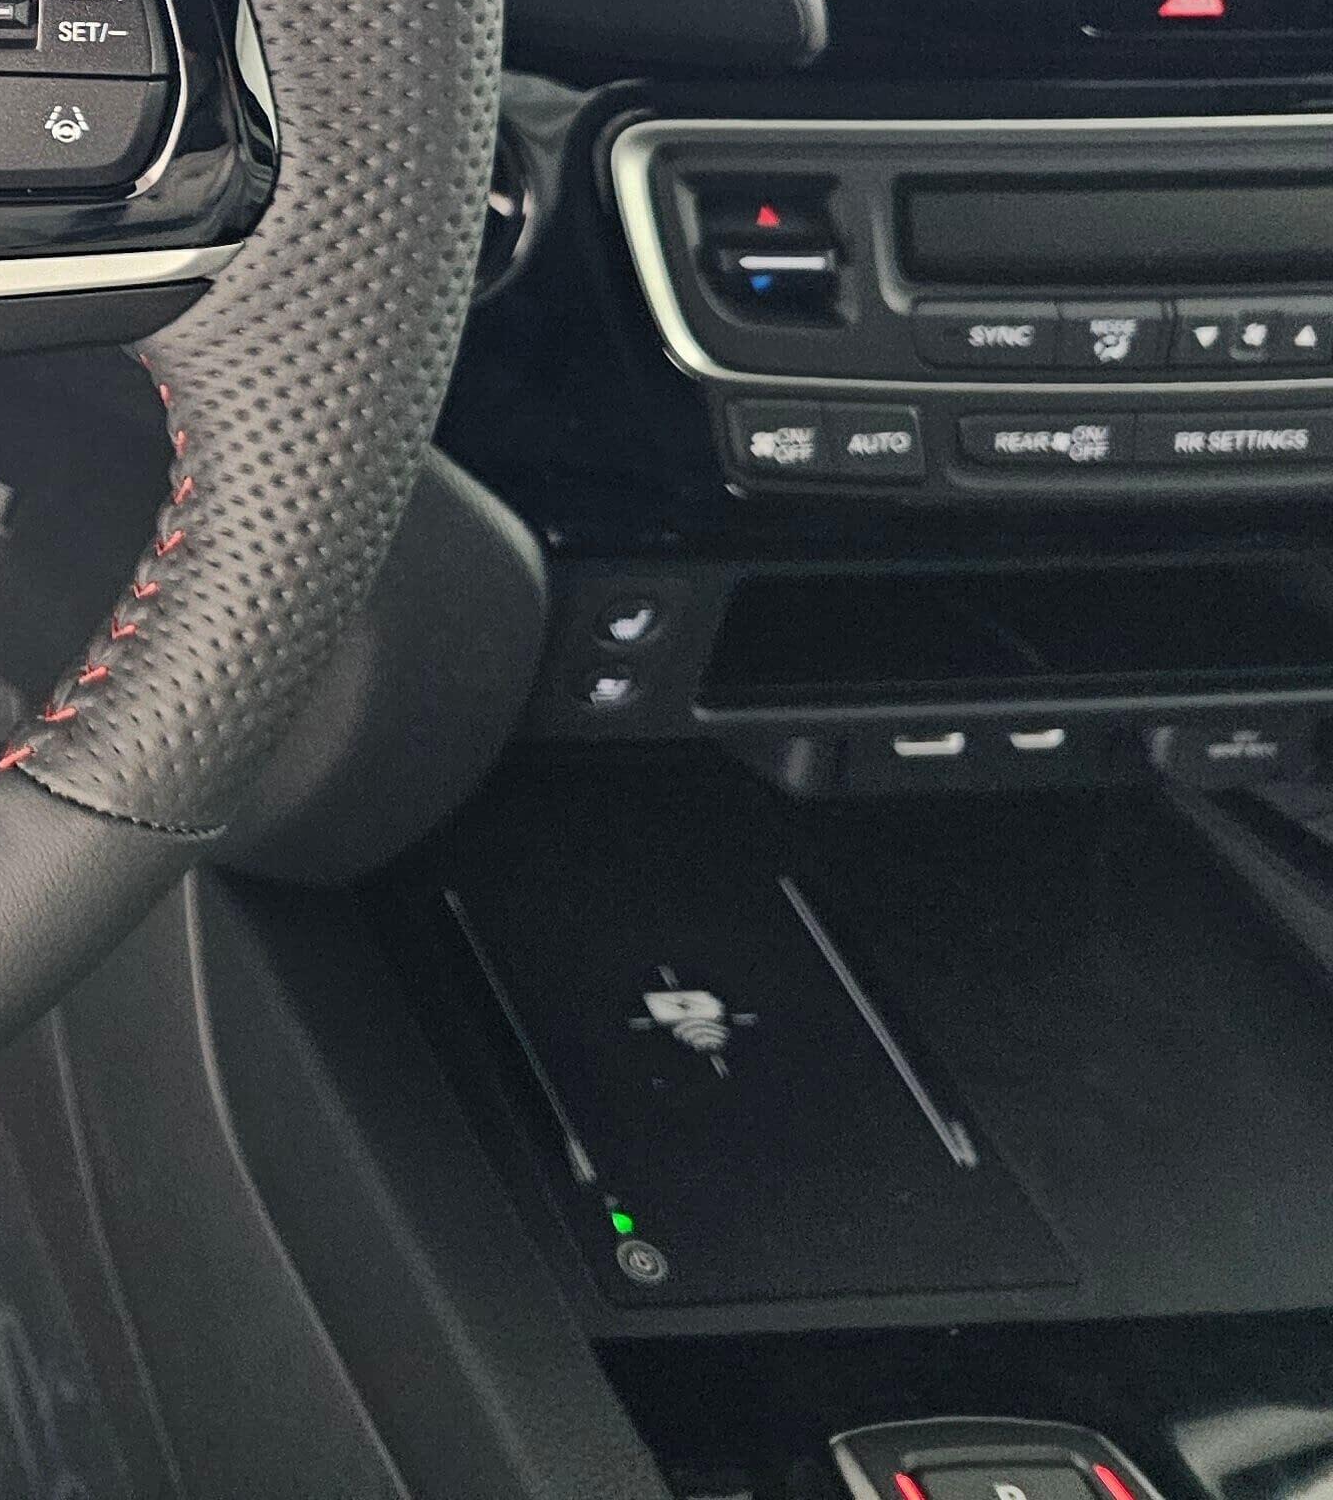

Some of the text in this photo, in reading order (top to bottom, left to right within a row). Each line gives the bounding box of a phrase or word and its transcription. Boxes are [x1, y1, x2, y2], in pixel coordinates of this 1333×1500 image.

[58, 21, 128, 44] SET/-
[968, 325, 1034, 348] SYNC
[847, 431, 912, 454] AUTO
[994, 431, 1052, 453] REAR
[1174, 429, 1309, 453] RR SETTINGS
